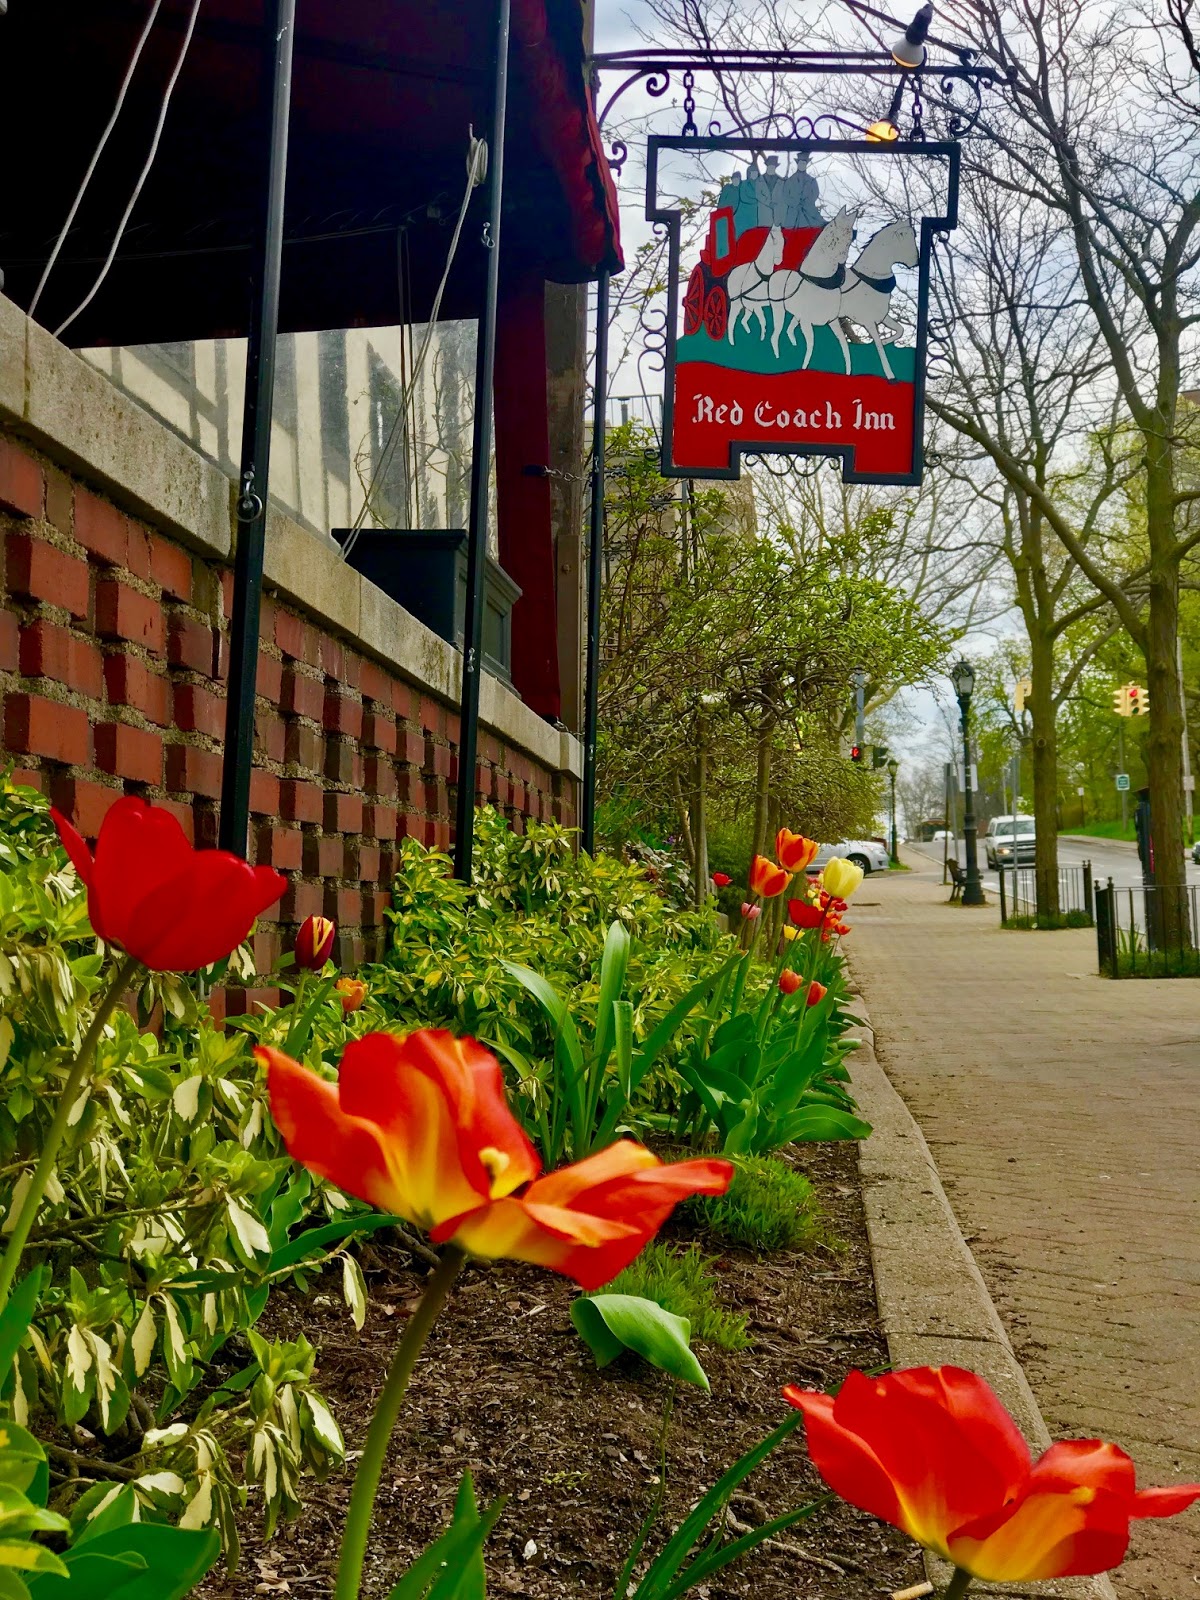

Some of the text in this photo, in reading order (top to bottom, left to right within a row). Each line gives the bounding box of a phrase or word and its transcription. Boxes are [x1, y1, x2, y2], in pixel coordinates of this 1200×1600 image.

[692, 394, 896, 430] Red Coach Inn
